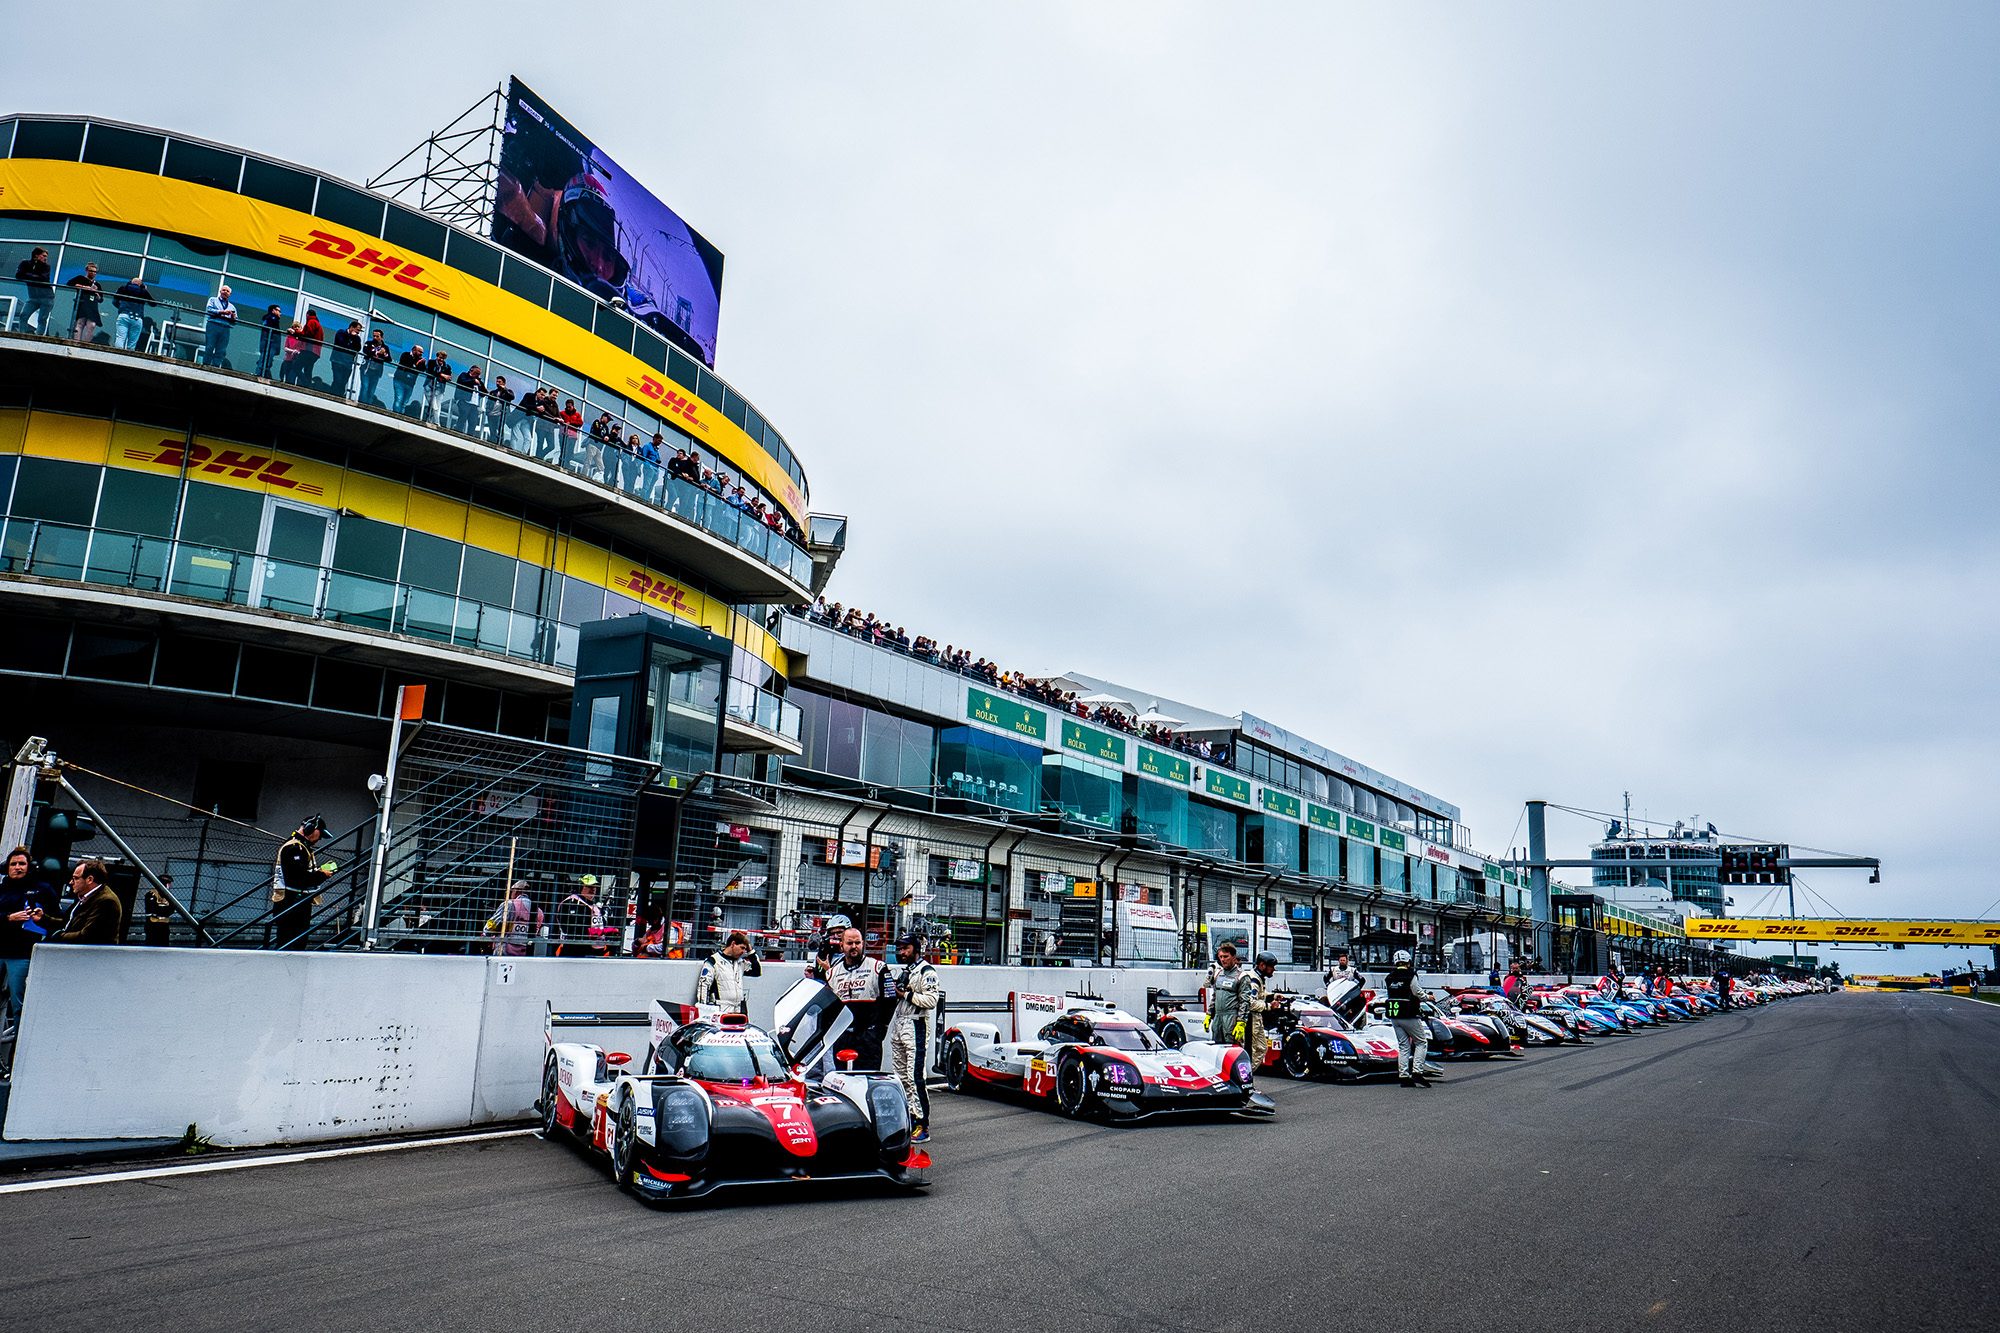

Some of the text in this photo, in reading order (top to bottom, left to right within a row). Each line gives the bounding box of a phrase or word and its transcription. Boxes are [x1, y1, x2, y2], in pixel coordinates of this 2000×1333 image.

[303, 229, 430, 291] DHL
[639, 374, 700, 425] DHL
[152, 439, 299, 489] DHL
[627, 569, 688, 612] DHL
[975, 708, 999, 724] ROLEX
[1015, 722, 1037, 736] ROLEX
[1067, 738, 1087, 751] ROLEX
[1100, 748, 1118, 761] ROLEX
[1142, 762, 1159, 774] ROLEX
[1169, 771, 1185, 781] ROLEX
[868, 787, 878, 799] 31
[1211, 784, 1225, 795] ROLEX
[1233, 791, 1246, 801] ROLEX
[1084, 886, 1090, 894] 2
[1130, 908, 1173, 921] PORSCHE
[1699, 924, 1741, 933] DHL
[1765, 925, 1809, 935] DHL
[1834, 927, 1881, 936] DHL
[1907, 928, 1956, 937] DHL
[837, 979, 867, 990] DENSO
[1021, 993, 1056, 1004] PORSCHE
[1026, 1002, 1055, 1013] DMG MORI
[655, 1019, 673, 1035] DENSO
[1047, 1064, 1056, 1075] P1
[1172, 1066, 1193, 1078] 2
[559, 1068, 573, 1087] DENSO
[1035, 1071, 1041, 1094] 2
[1110, 1086, 1141, 1094] CHOPARD
[637, 1108, 656, 1116] AISIN
[772, 1104, 793, 1120] 7
[791, 1137, 812, 1145] ZENT
[642, 1176, 672, 1190] MICHELIN
